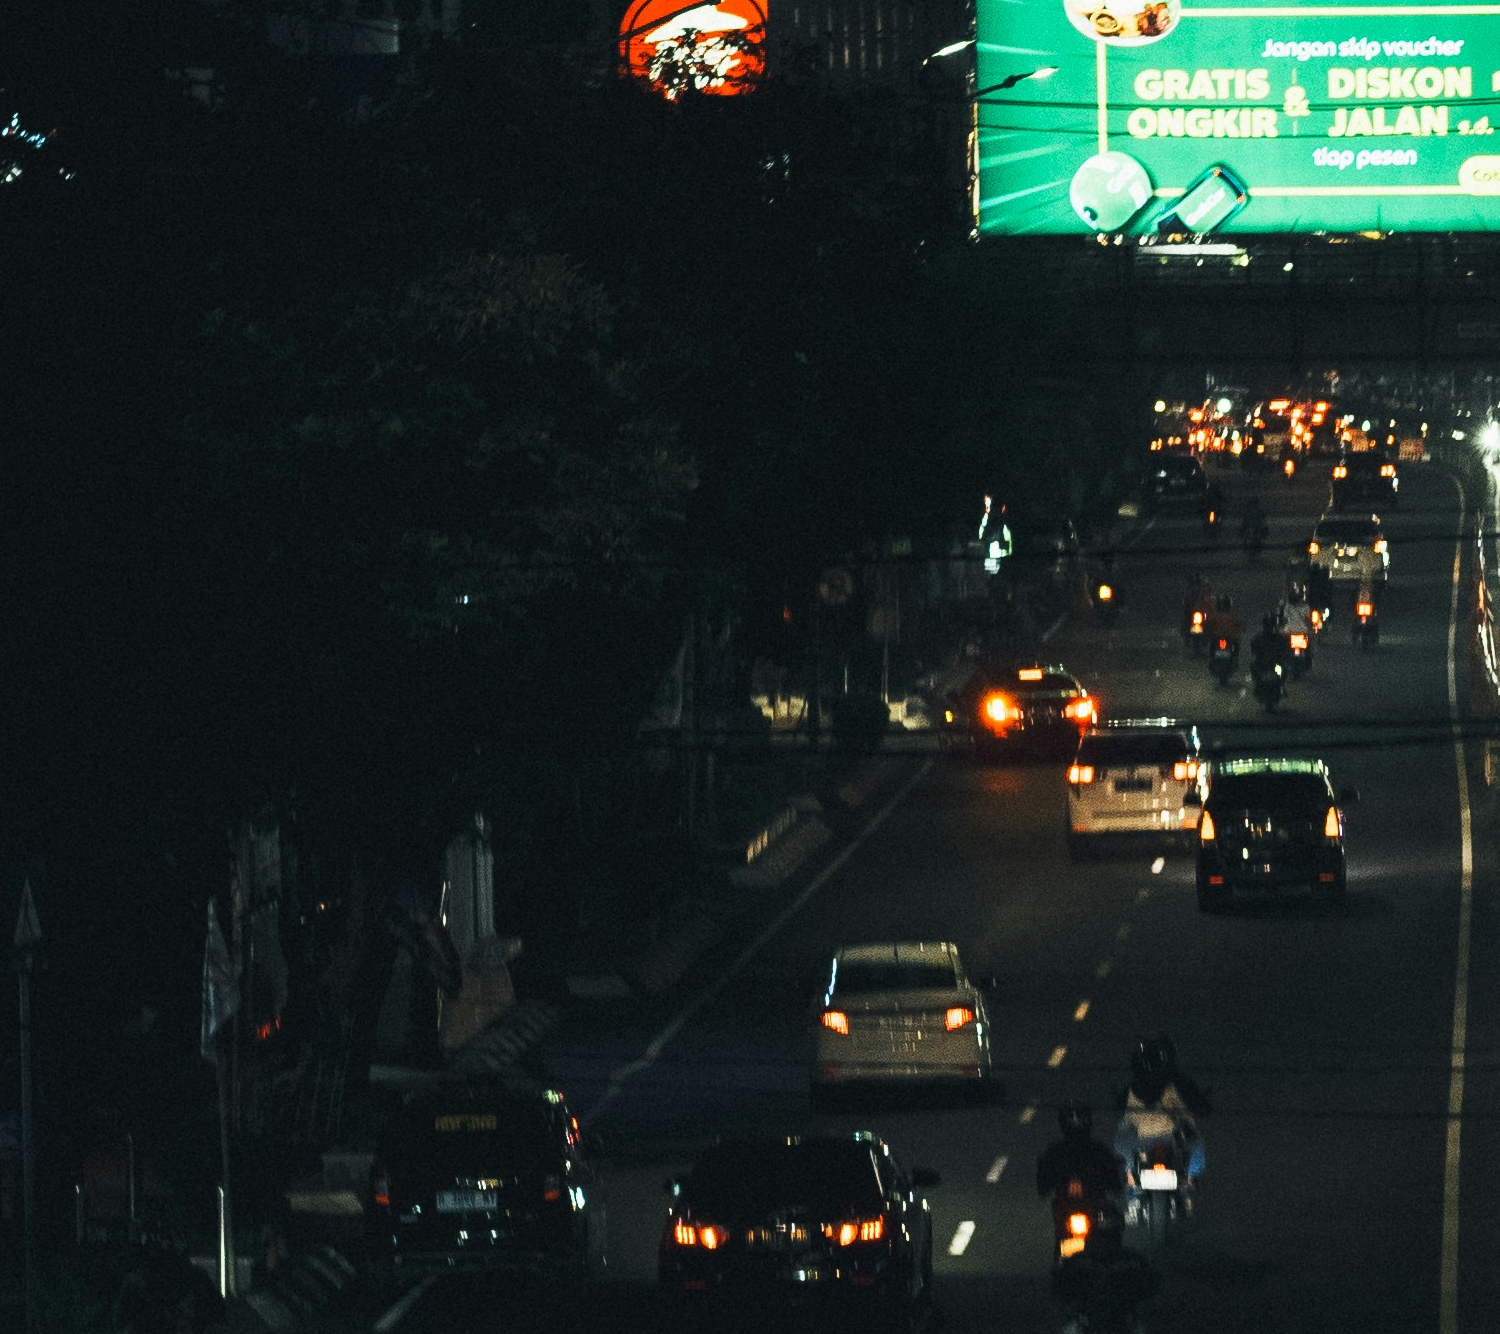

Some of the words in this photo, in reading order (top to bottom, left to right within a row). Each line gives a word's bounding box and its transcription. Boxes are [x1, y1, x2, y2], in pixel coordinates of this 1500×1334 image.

[1261, 39, 1337, 61] Jangan
[1338, 37, 1381, 60] skip
[1382, 36, 1465, 57] voucher
[1133, 69, 1271, 101] GRATIS
[1327, 67, 1472, 99] DISKON
[1283, 85, 1311, 117] &
[1126, 107, 1278, 140] ONGKIR
[1327, 105, 1449, 138] JALAN
[1312, 146, 1354, 169] tiap
[1356, 146, 1417, 170] pesen
